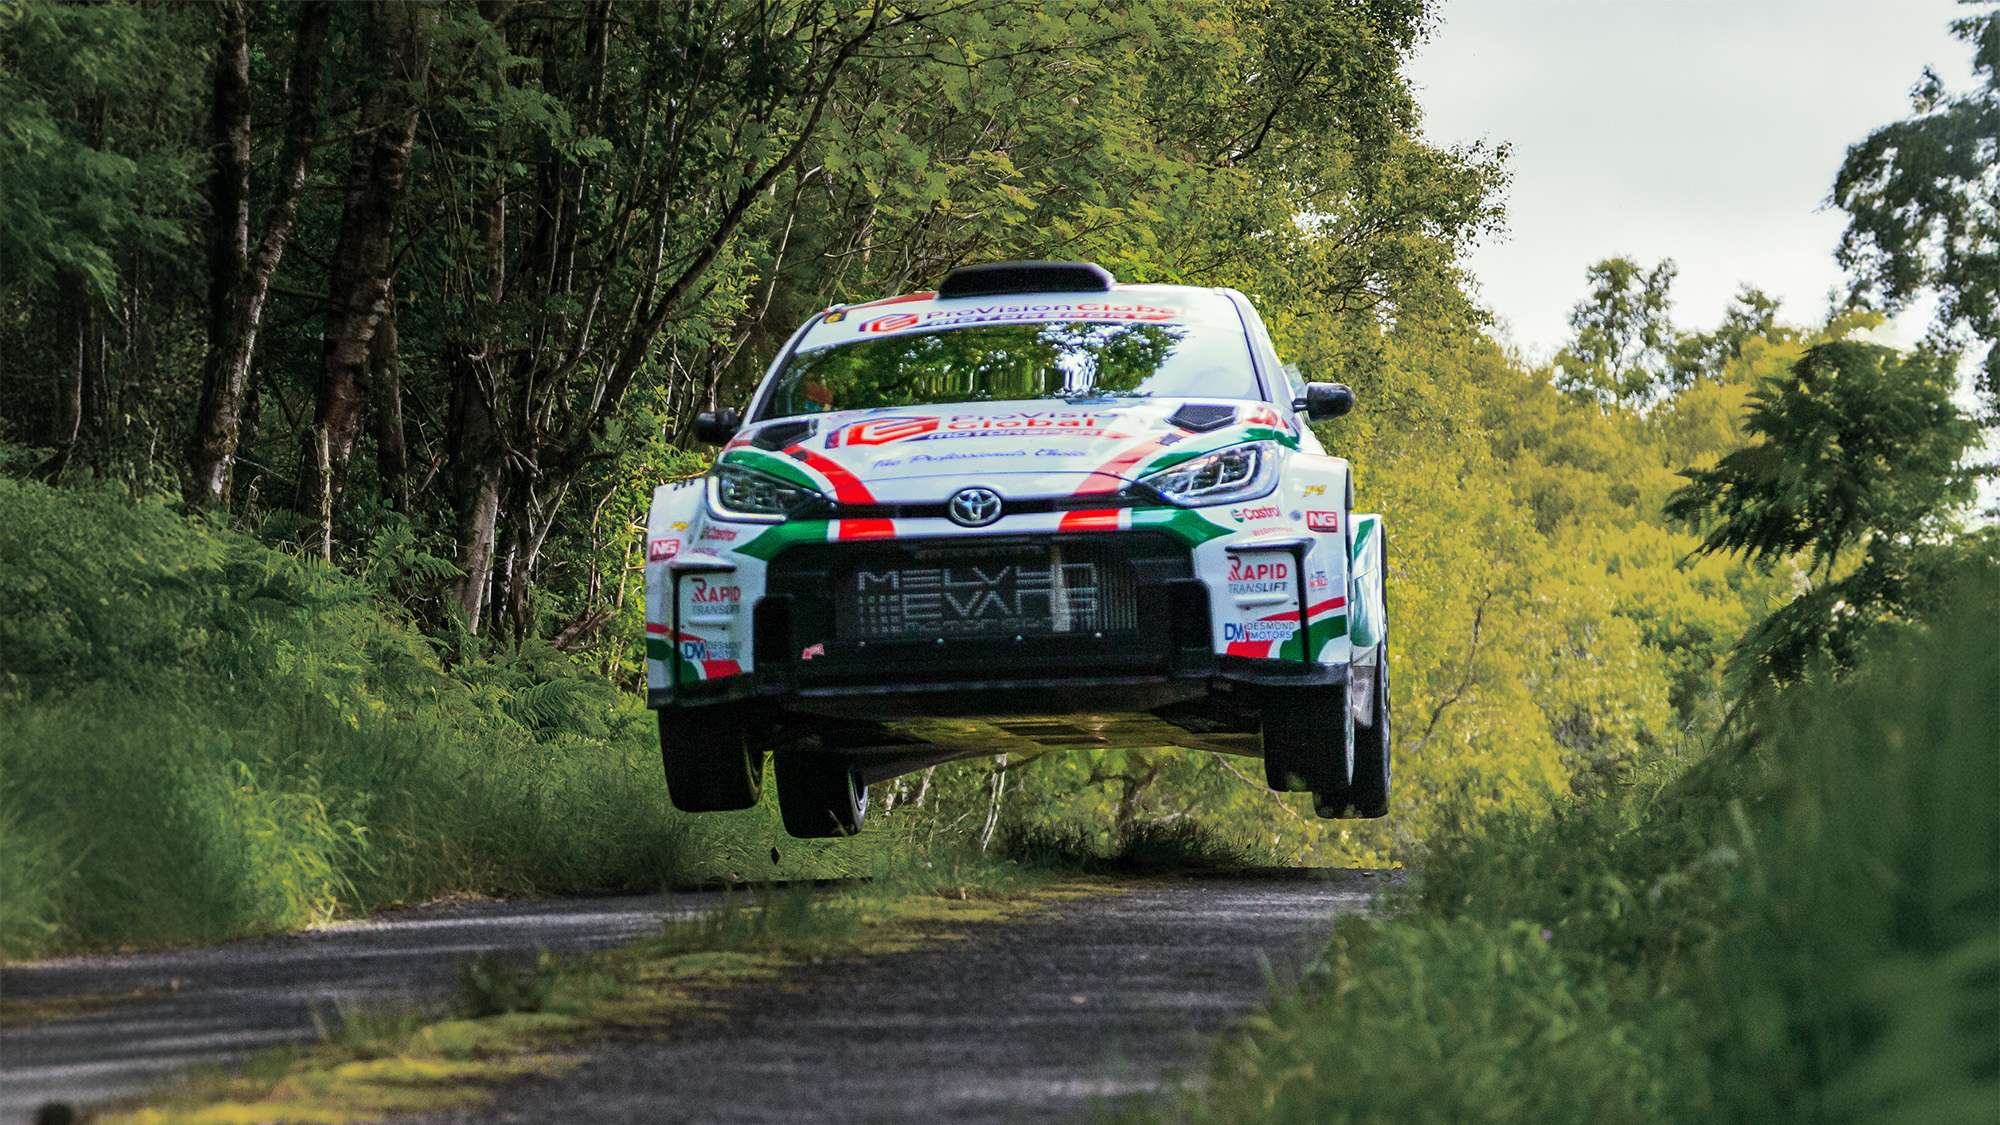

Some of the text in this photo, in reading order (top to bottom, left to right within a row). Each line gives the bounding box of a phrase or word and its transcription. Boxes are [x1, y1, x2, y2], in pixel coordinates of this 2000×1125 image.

[948, 417, 1095, 429] Global
[1310, 512, 1336, 527] NG
[652, 541, 676, 553] NG
[1227, 555, 1288, 581] RAPID
[691, 578, 741, 602] RAPID
[1229, 582, 1288, 593] TRANSLIFT
[1247, 622, 1295, 630] DESMOND
[1250, 631, 1292, 640] MOTORS
